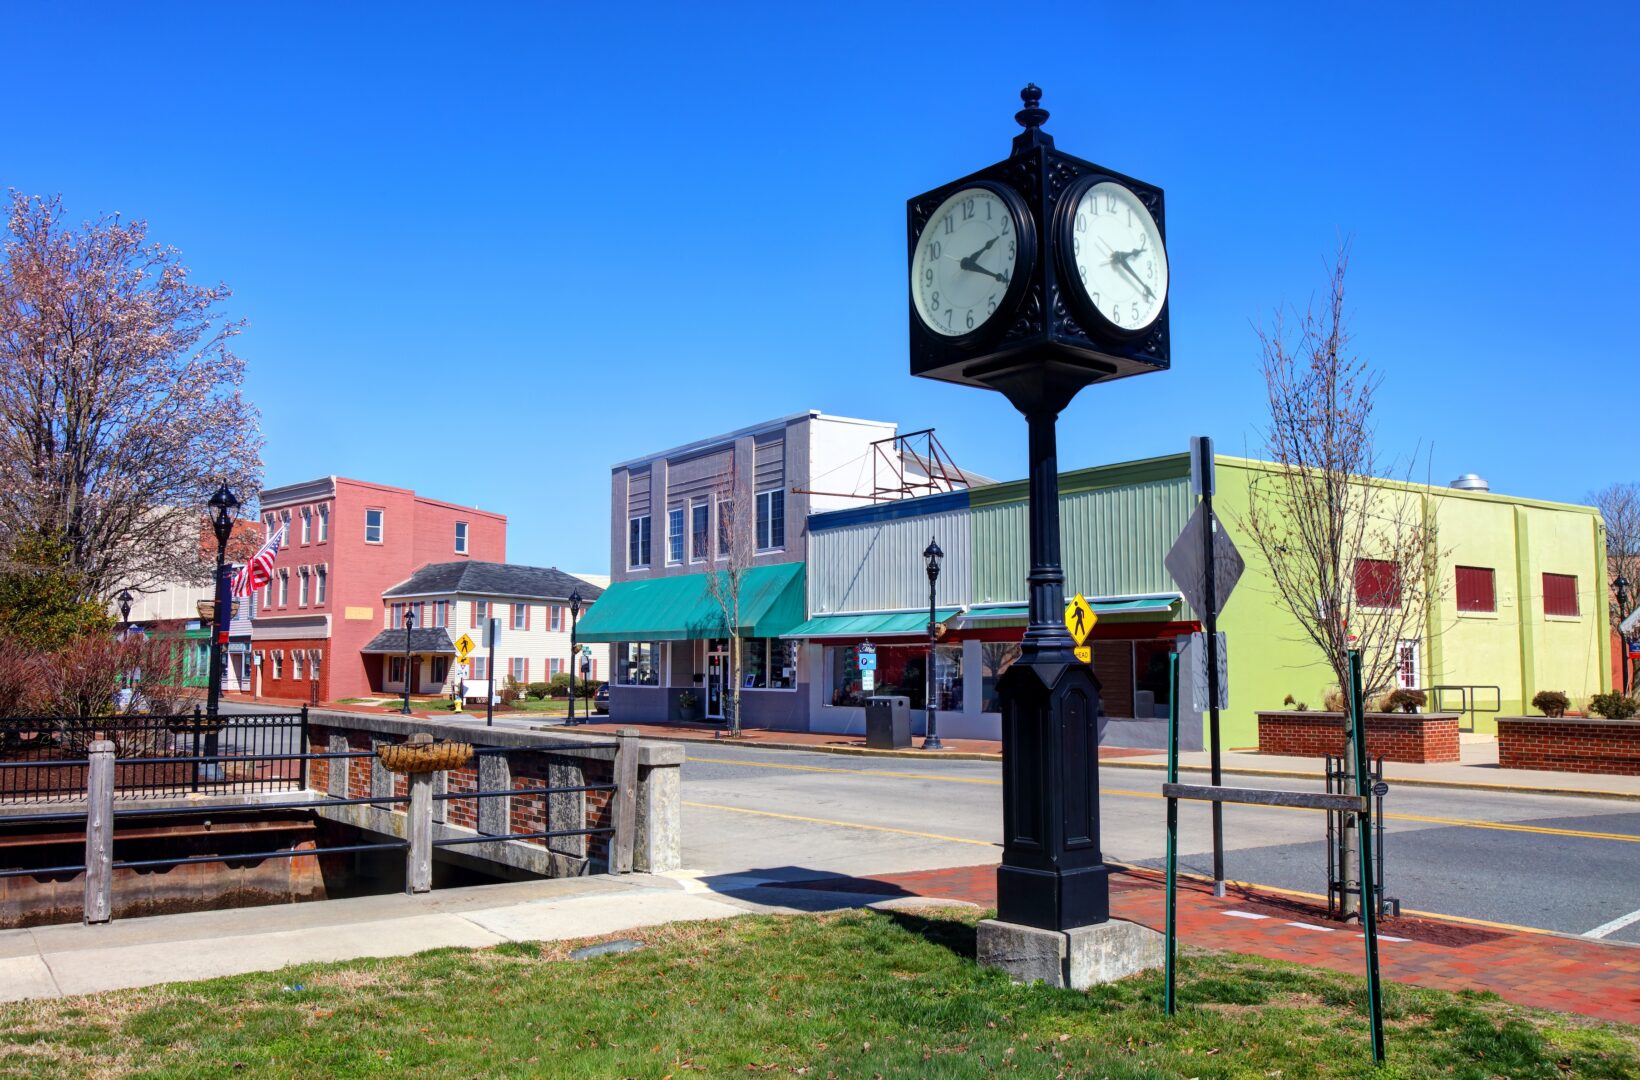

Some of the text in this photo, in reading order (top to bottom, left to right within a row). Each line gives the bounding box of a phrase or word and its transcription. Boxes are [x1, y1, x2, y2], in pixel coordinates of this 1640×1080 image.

[962, 200, 974, 220] 12
[986, 201, 992, 220] 1
[1089, 195, 1099, 216] 11
[1105, 194, 1117, 214] 12
[944, 216, 954, 235] 11
[1001, 215, 1009, 236] 2
[1076, 213, 1087, 233] 10
[1127, 208, 1132, 228] 1
[928, 240, 941, 261] 10
[1008, 240, 1015, 260] 3
[1140, 232, 1147, 251] 2
[926, 268, 933, 287] 9
[1080, 265, 1087, 285] 8
[1147, 261, 1153, 279] 3
[931, 291, 939, 311] 8
[987, 293, 996, 315] 5
[1131, 301, 1139, 321] 5
[944, 309, 953, 328] 7
[966, 309, 974, 329] 6
[1113, 304, 1120, 324] 6
